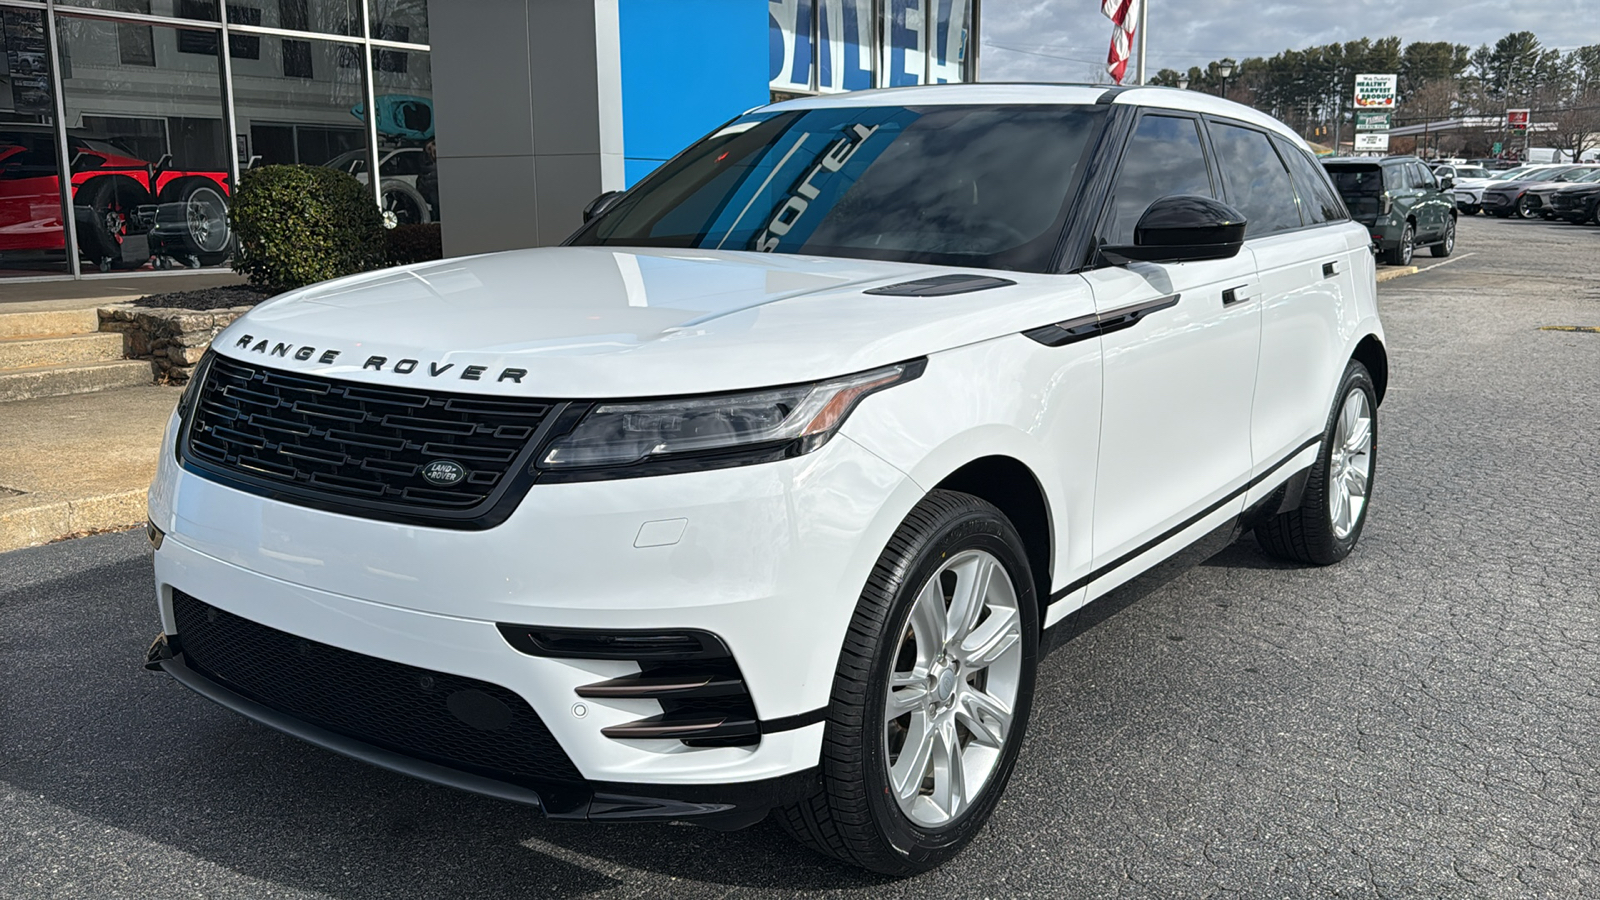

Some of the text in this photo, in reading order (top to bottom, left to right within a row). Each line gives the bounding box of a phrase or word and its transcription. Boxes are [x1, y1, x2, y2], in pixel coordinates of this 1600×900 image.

[236, 334, 528, 383] RANGE ROVER
[431, 471, 456, 480] ROVER
